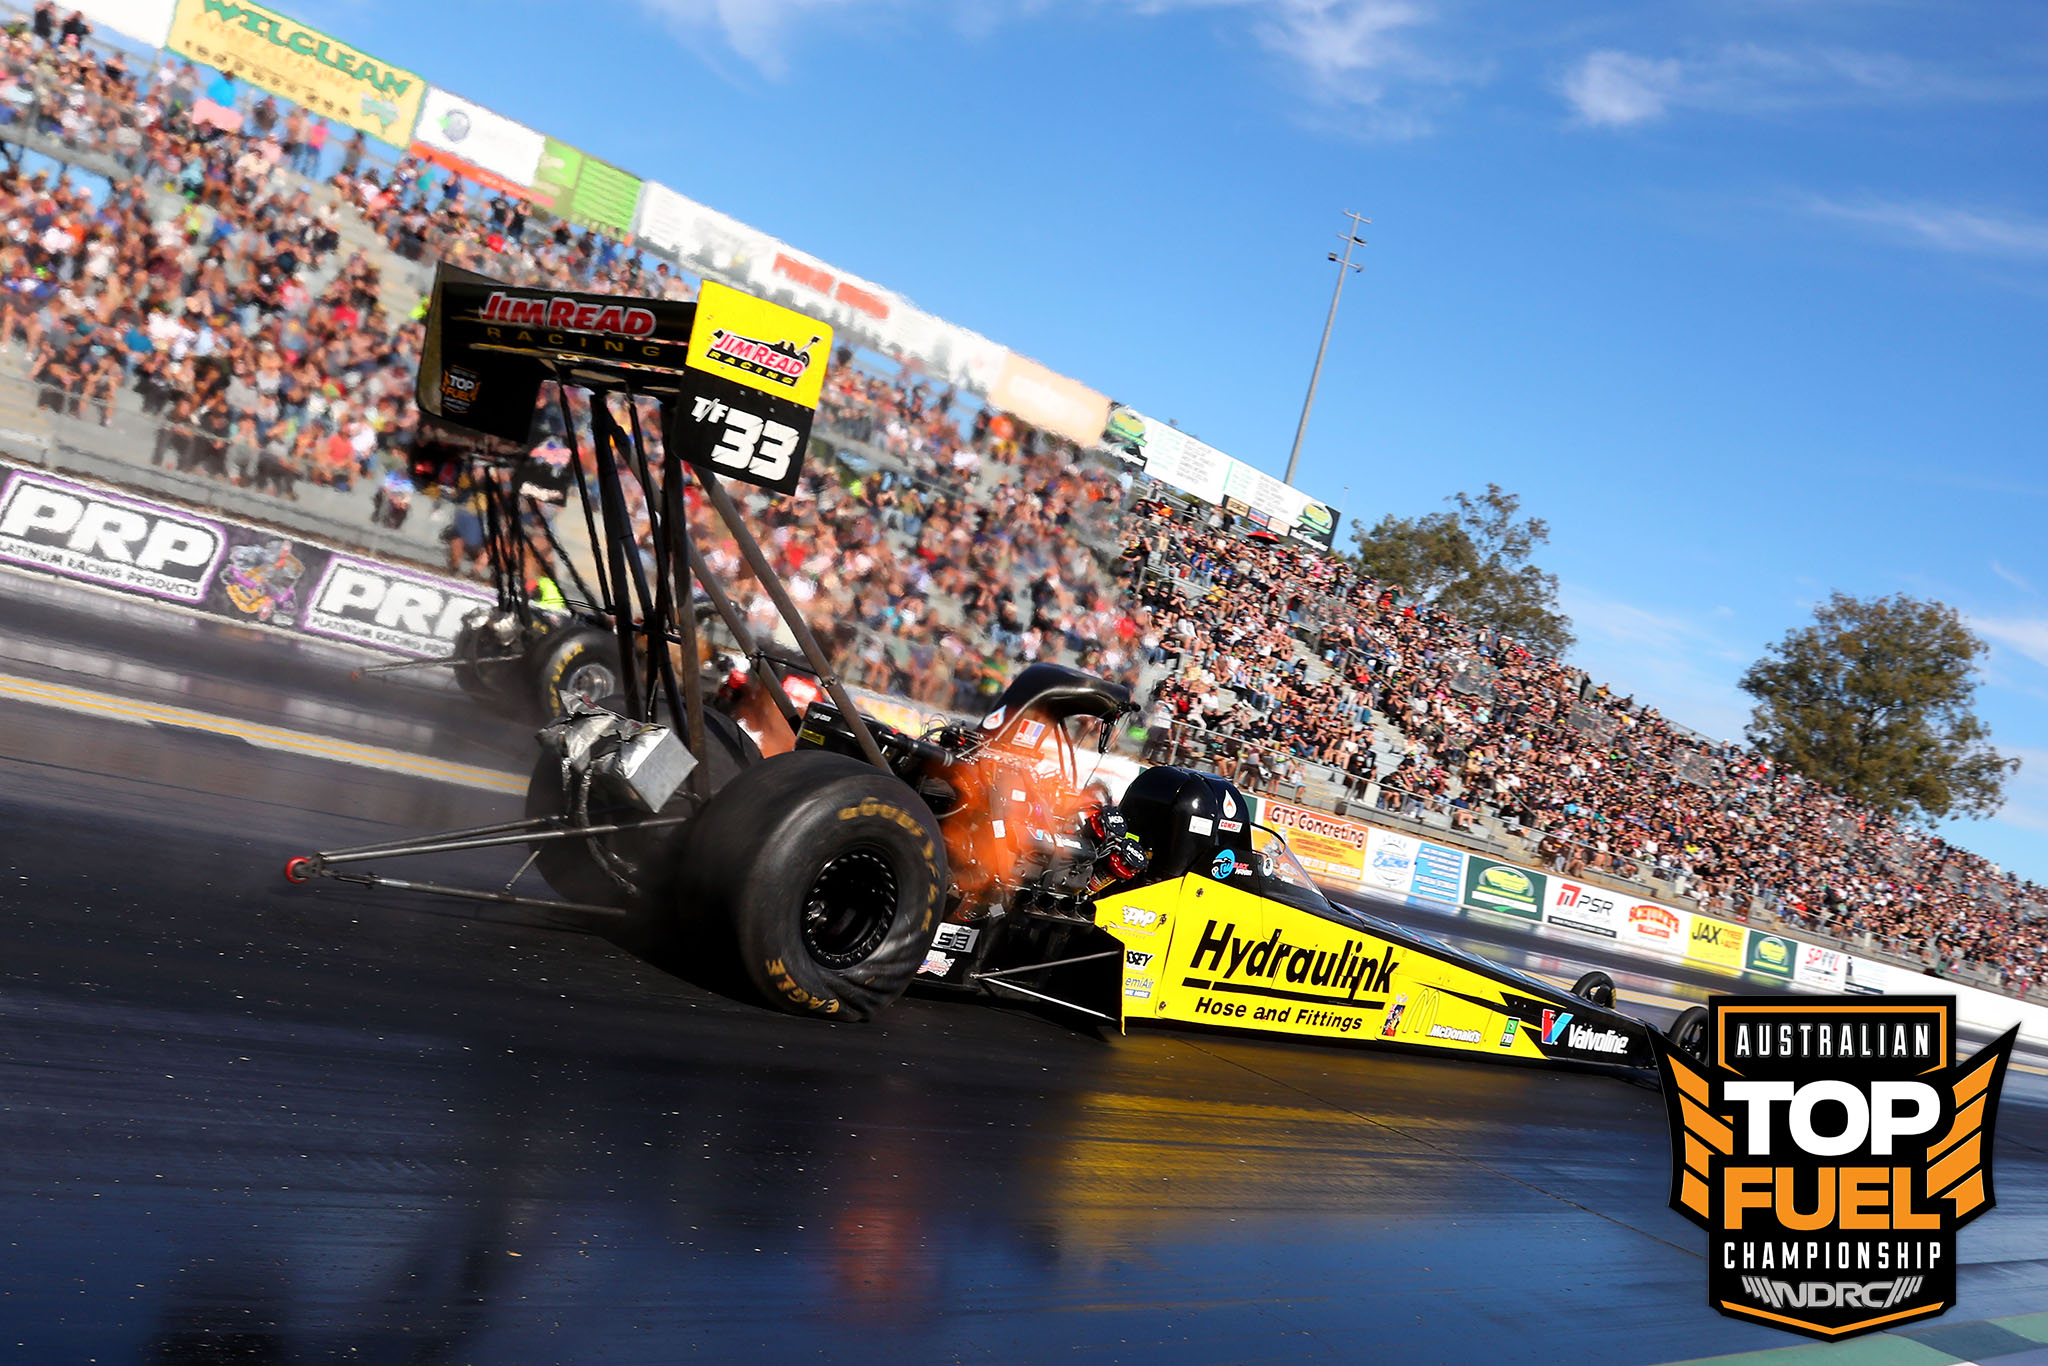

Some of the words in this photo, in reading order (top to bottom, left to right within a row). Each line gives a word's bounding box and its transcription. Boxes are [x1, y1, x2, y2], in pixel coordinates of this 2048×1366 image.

[204, 0, 411, 97] WILCLEAN
[487, 327, 661, 357] RACING
[450, 374, 475, 391] TOP
[709, 350, 795, 386] RACING
[710, 407, 800, 481] 33
[0, 484, 215, 570] PRP
[127, 571, 198, 596] PRODUCTS
[1108, 815, 1124, 824] MSD
[1271, 807, 1296, 826] GTS
[1299, 814, 1365, 849] Concreting
[1577, 894, 1614, 916] PSR
[1692, 922, 1723, 945] JAX
[1190, 919, 1399, 996] Hydraulink
[1195, 996, 1247, 1018] Hose
[1253, 1003, 1291, 1022] and
[1296, 1006, 1363, 1031] Fittings
[1430, 1024, 1481, 1043] McDonald's
[1568, 1023, 1629, 1054] Valvoline
